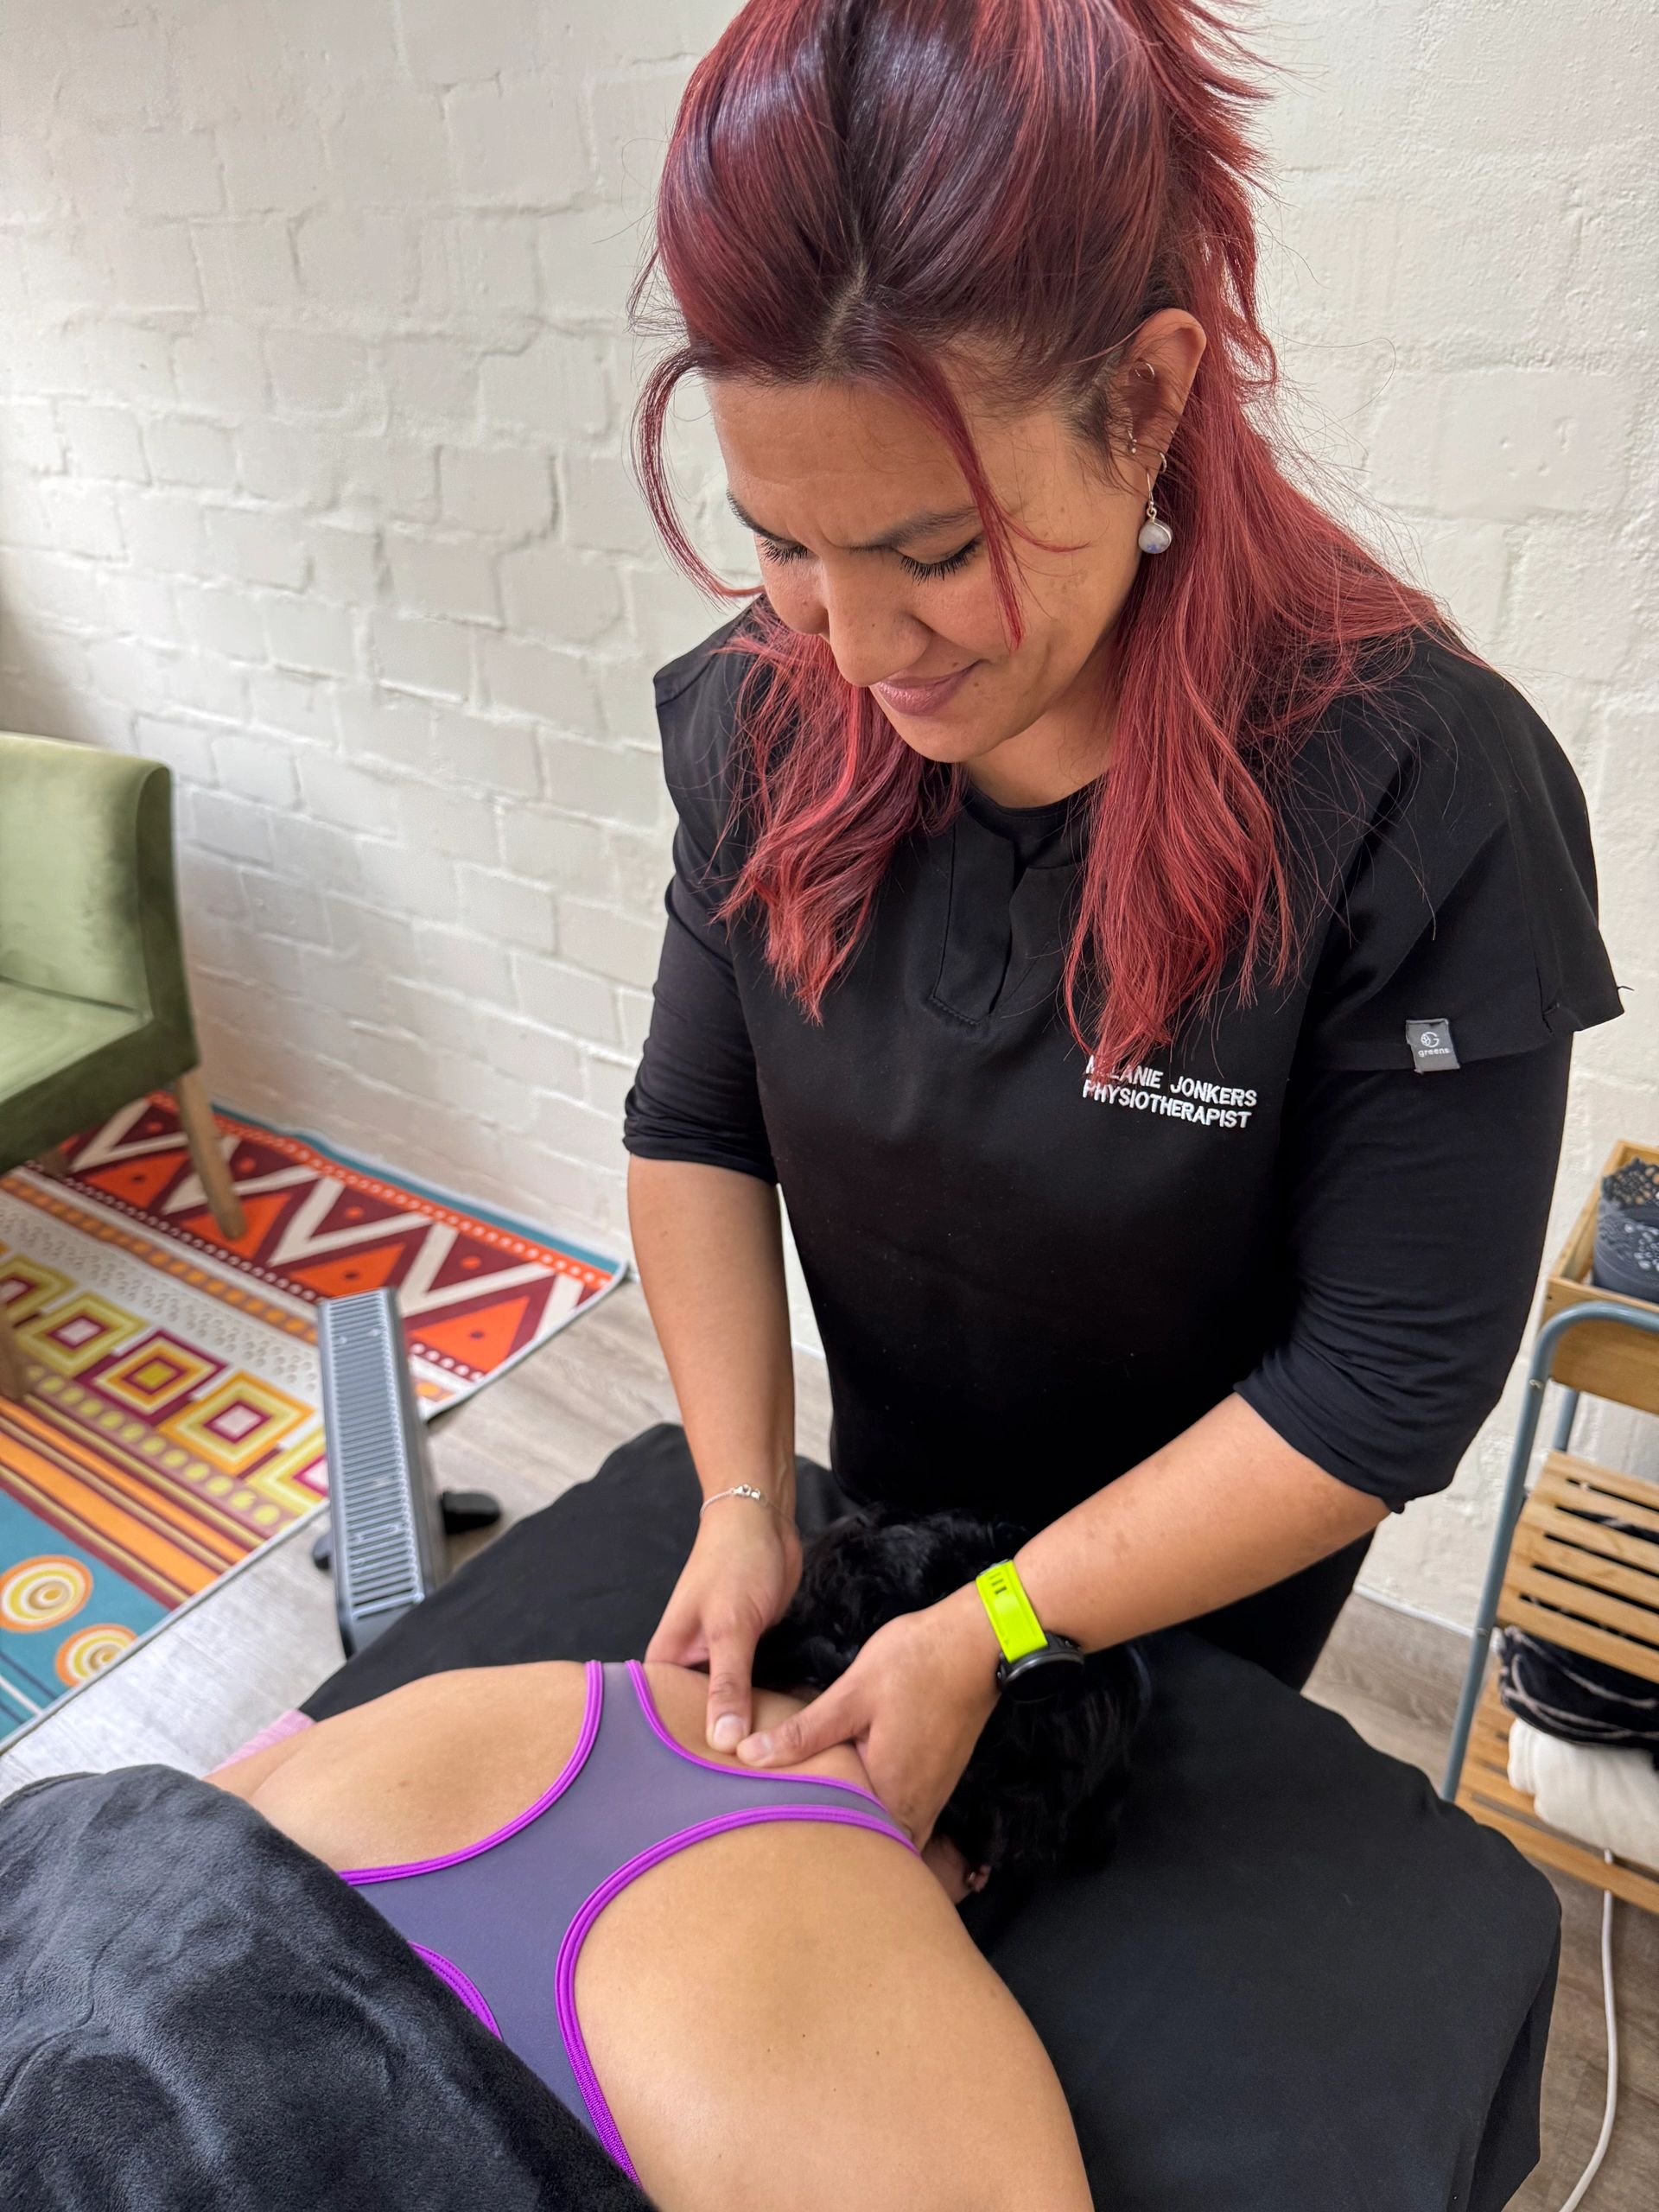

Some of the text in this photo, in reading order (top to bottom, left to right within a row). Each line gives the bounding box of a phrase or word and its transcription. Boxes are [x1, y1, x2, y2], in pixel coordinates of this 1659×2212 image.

[1418, 1047, 1450, 1058] greens
[1082, 1078, 1252, 1128] PHYSIOTHERAPIST
[1085, 1054, 1257, 1107] LANIE JONKERS
